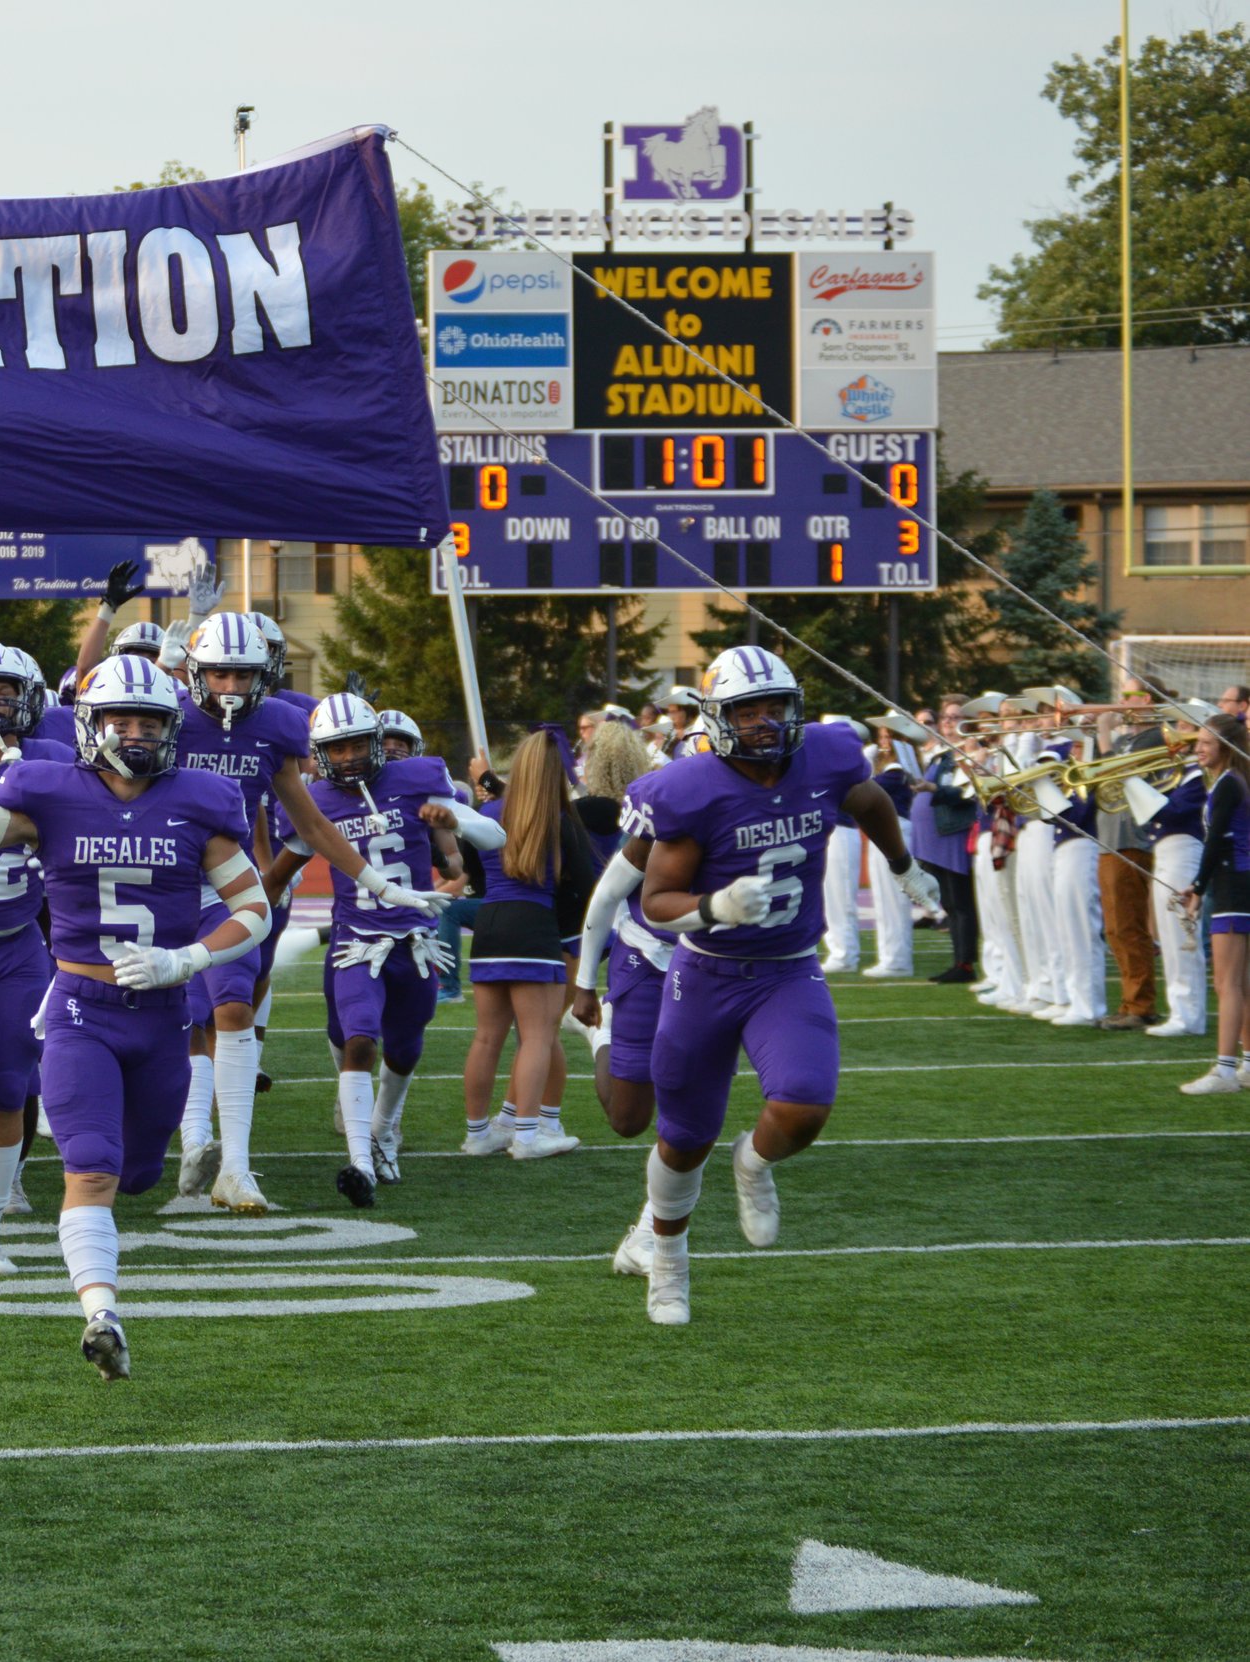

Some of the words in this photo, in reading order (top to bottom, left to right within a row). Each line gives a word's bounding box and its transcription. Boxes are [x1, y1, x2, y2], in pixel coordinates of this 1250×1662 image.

[448, 208, 513, 242] ST.
[527, 208, 708, 242] FRANCIS
[722, 208, 914, 242] DESALES
[489, 271, 555, 293] pepsi
[594, 267, 772, 299] WELCOME
[664, 309, 702, 338] to
[848, 319, 924, 330] FARMERS
[470, 333, 566, 348] OhioHealth
[846, 343, 891, 353] Chapman
[612, 344, 755, 377] ALUMNI
[852, 353, 897, 363] Chapman
[442, 381, 546, 405] DONATOS
[606, 383, 764, 417] STADIUM
[439, 435, 547, 464] STALLIONS
[828, 434, 920, 462] GUEST
[479, 465, 508, 510] 0
[890, 463, 918, 508] 0
[449, 522, 470, 557] 3
[506, 517, 570, 540] DOWN
[598, 517, 624, 540] TO
[630, 517, 660, 540] GO
[704, 517, 750, 540] BALL
[754, 517, 781, 540] ON
[807, 516, 851, 540] QTR
[898, 520, 919, 555] 3
[21, 545, 45, 558] 2019
[831, 544, 843, 583] 1
[13, 578, 30, 590] The
[34, 578, 77, 590] Tradition
[877, 562, 930, 586] T.O.L.
[735, 810, 823, 850] DESALES
[74, 836, 177, 866] DESALES
[98, 867, 155, 961] 5
